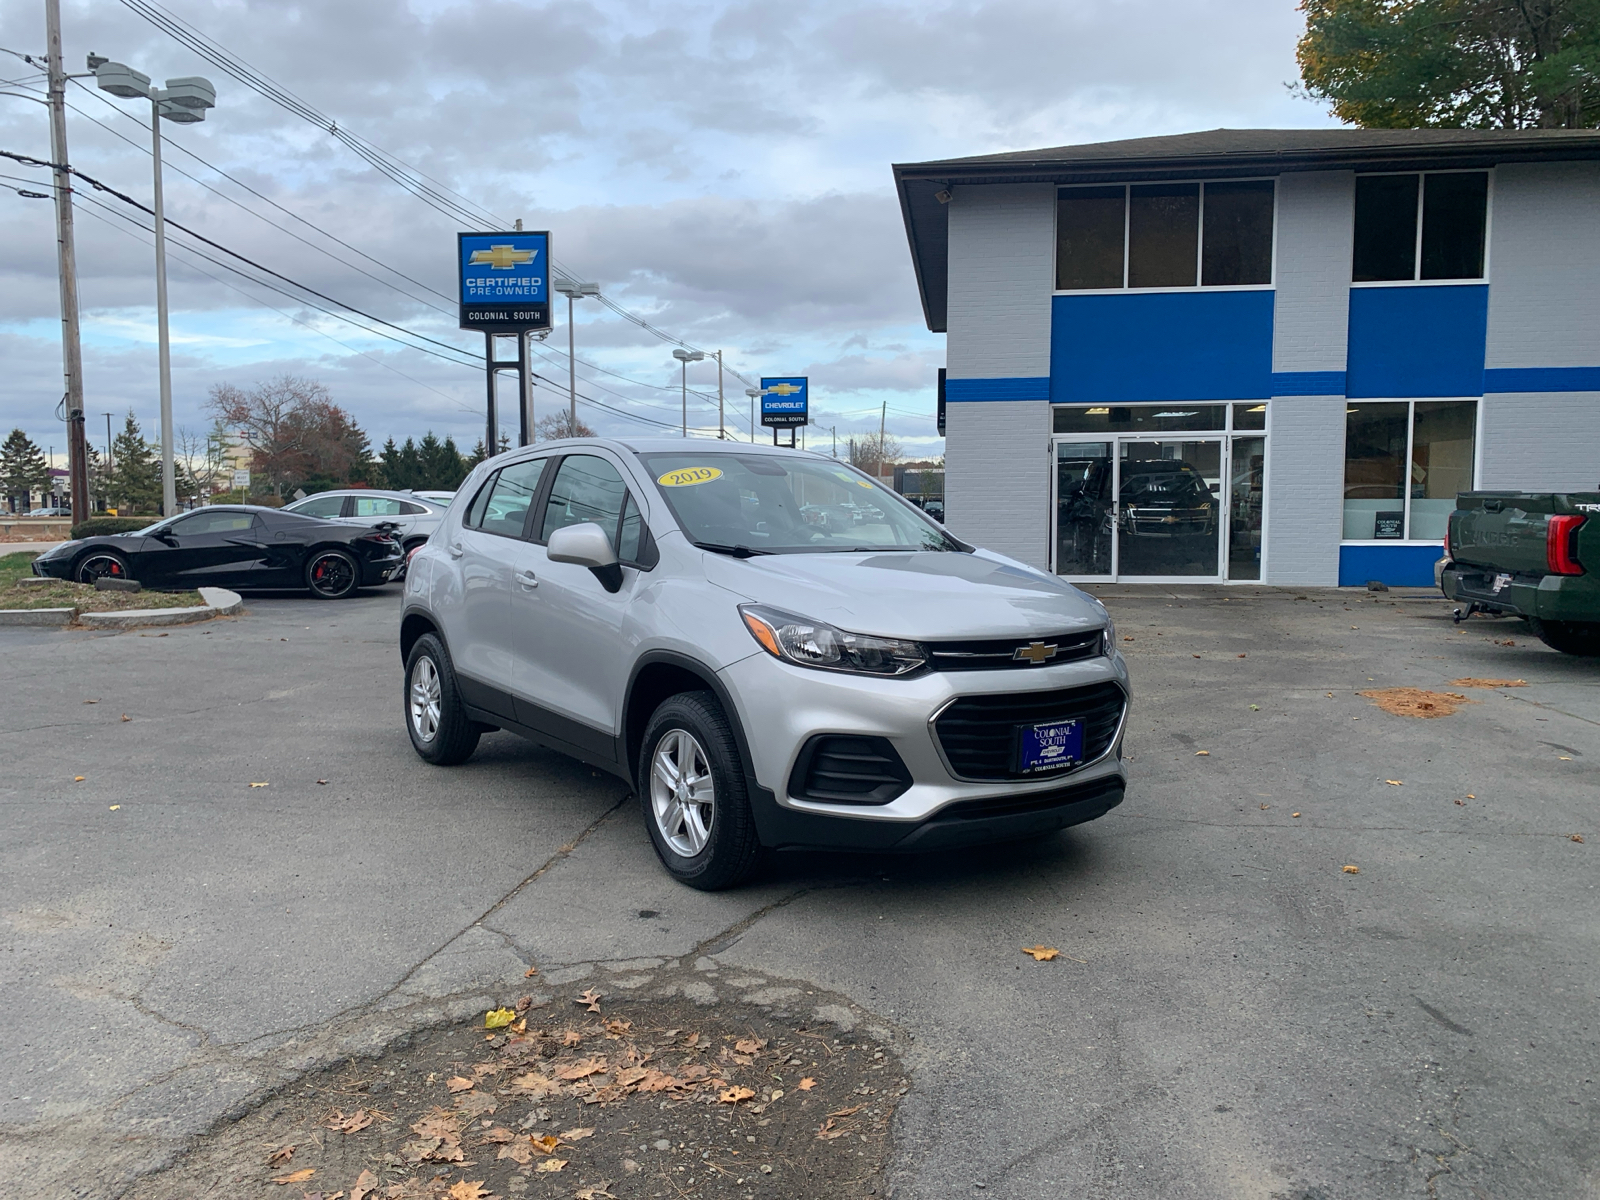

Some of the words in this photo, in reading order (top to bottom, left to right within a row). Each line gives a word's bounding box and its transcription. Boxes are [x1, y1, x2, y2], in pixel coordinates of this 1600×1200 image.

[466, 277, 542, 287] CERTIFIED
[469, 287, 538, 296] PRE-OWNED
[468, 312, 509, 320] COLONIAL
[513, 311, 541, 320] SOUTH
[670, 468, 712, 485] 2019
[1574, 503, 1600, 513] TR
[1034, 726, 1072, 740] COLONIAL
[1039, 736, 1067, 748] SOUTH
[1042, 747, 1064, 755] CHEVROLET
[1034, 764, 1056, 772] COLONIAL
